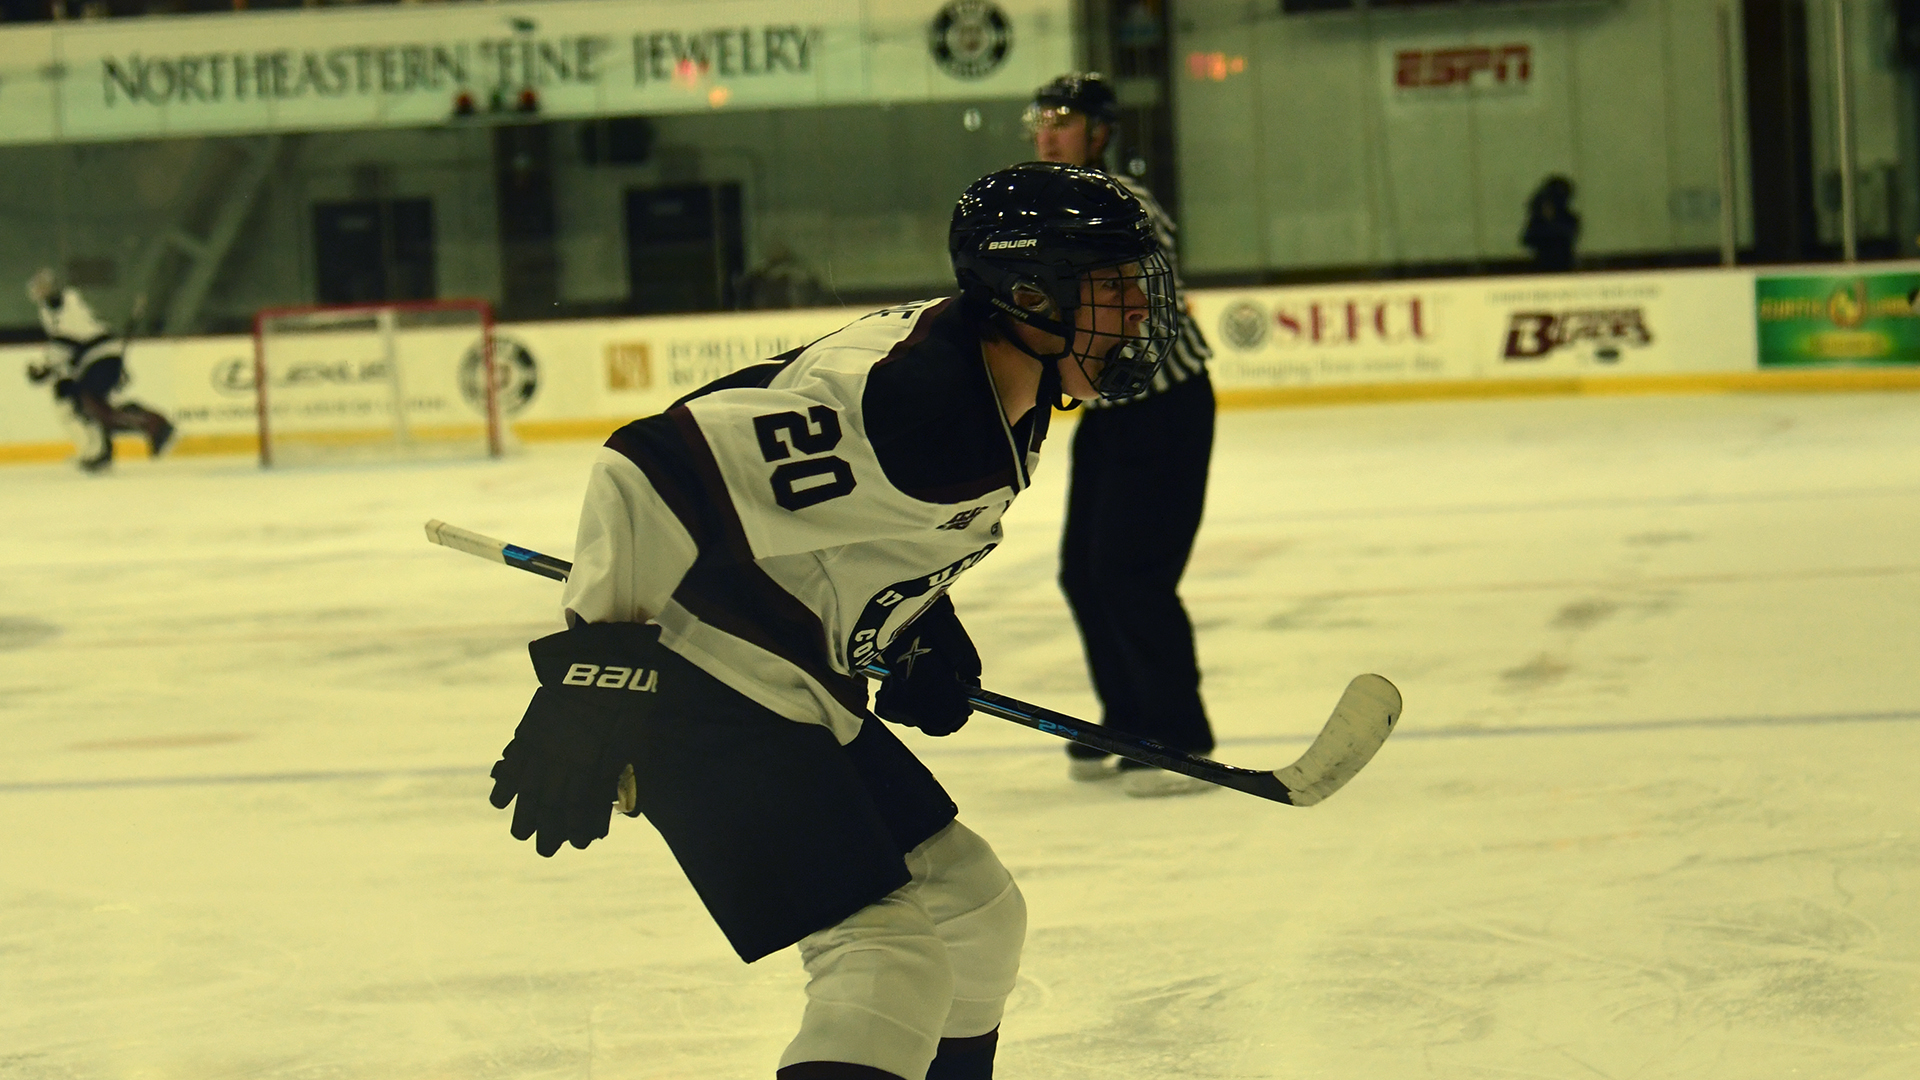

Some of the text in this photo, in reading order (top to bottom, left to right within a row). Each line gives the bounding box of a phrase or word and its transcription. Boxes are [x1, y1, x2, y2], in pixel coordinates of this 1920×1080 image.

[101, 46, 467, 107] NORTHEASTERN
[633, 24, 822, 88] JEWELRY
[1394, 43, 1530, 88] ESPN
[988, 238, 1037, 250] BAUER
[1271, 294, 1436, 346] SEFCU
[752, 405, 857, 512] 20
[876, 590, 904, 607] 17
